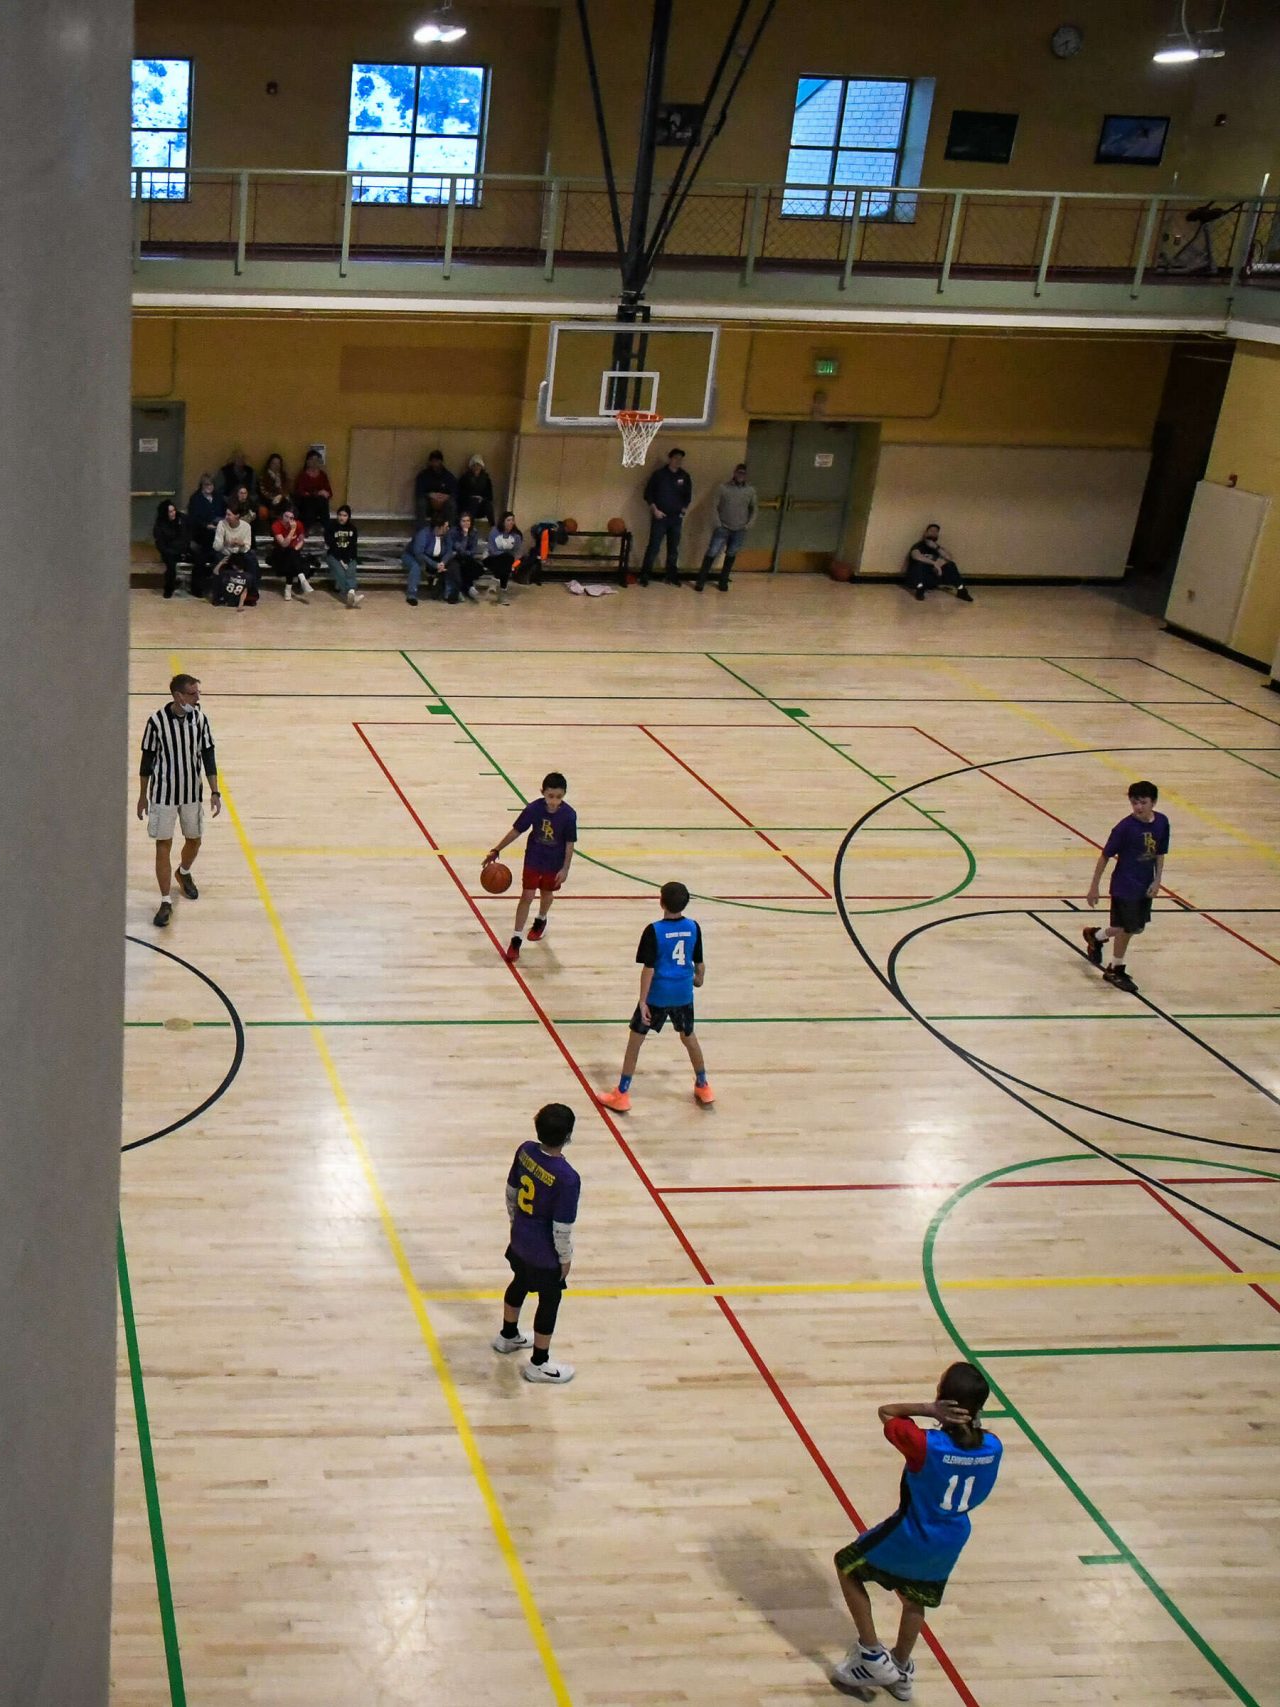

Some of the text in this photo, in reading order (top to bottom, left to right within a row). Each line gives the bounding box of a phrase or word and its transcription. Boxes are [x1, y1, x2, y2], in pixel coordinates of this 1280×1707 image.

[226, 582, 244, 596] 88
[672, 940, 686, 966] 4
[517, 1174, 535, 1216] 2
[939, 1474, 976, 1513] 11
